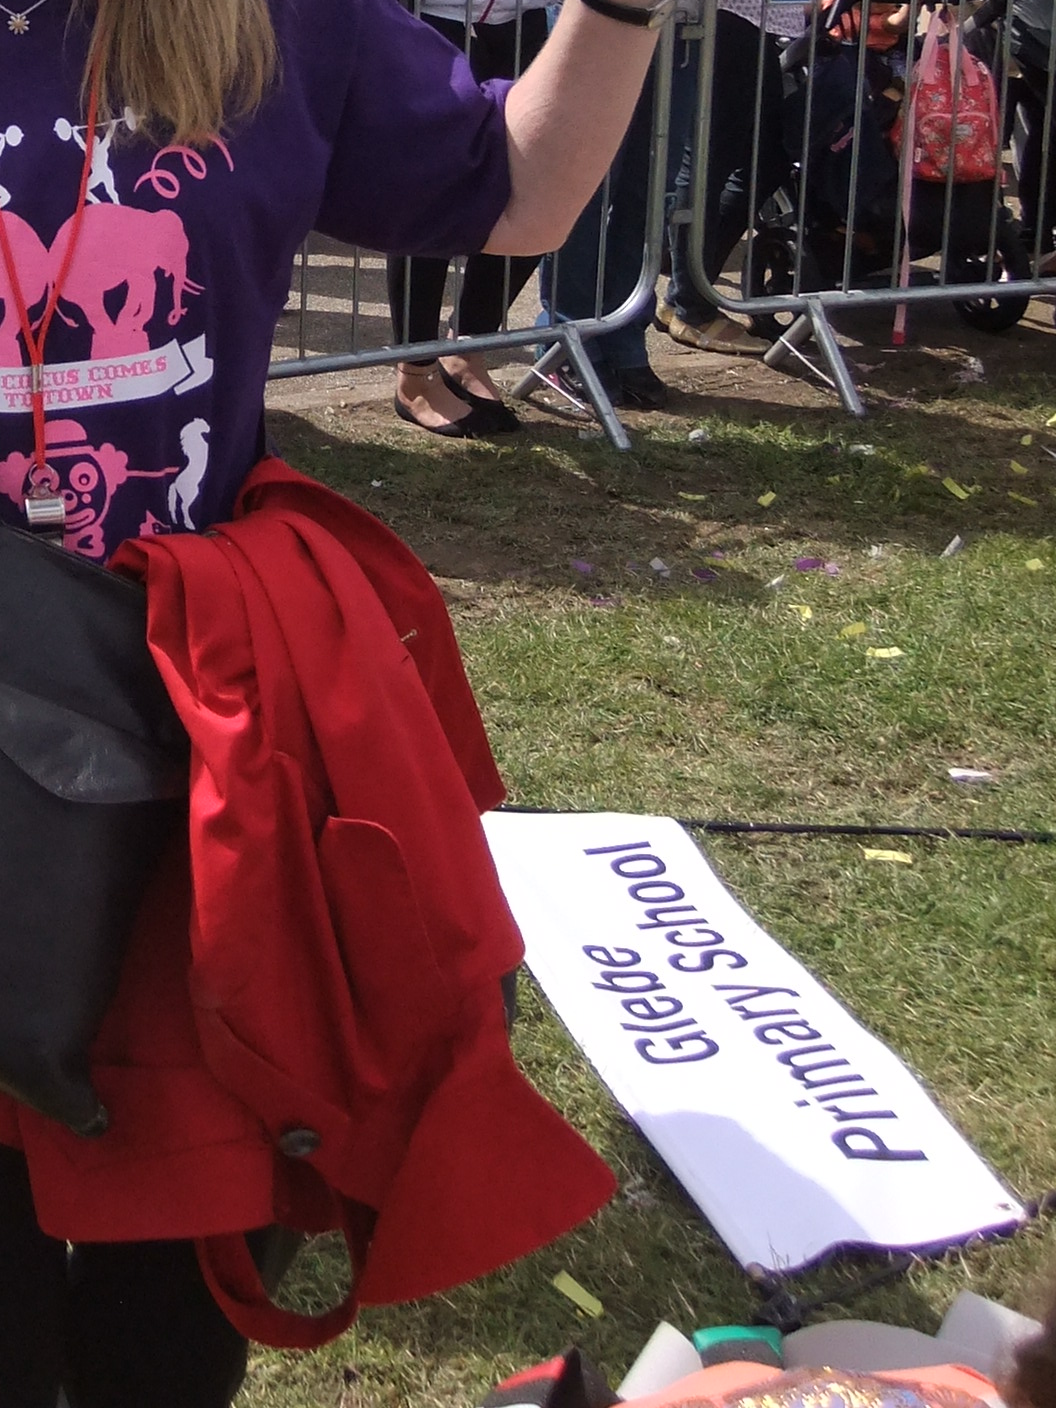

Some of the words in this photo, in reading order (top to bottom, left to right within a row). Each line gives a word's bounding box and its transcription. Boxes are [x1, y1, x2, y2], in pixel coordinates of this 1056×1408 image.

[43, 383, 113, 405] TOWN
[88, 355, 167, 382] COMES
[582, 840, 749, 973] School
[582, 943, 721, 1065] Glebe
[714, 983, 930, 1162] Primary
